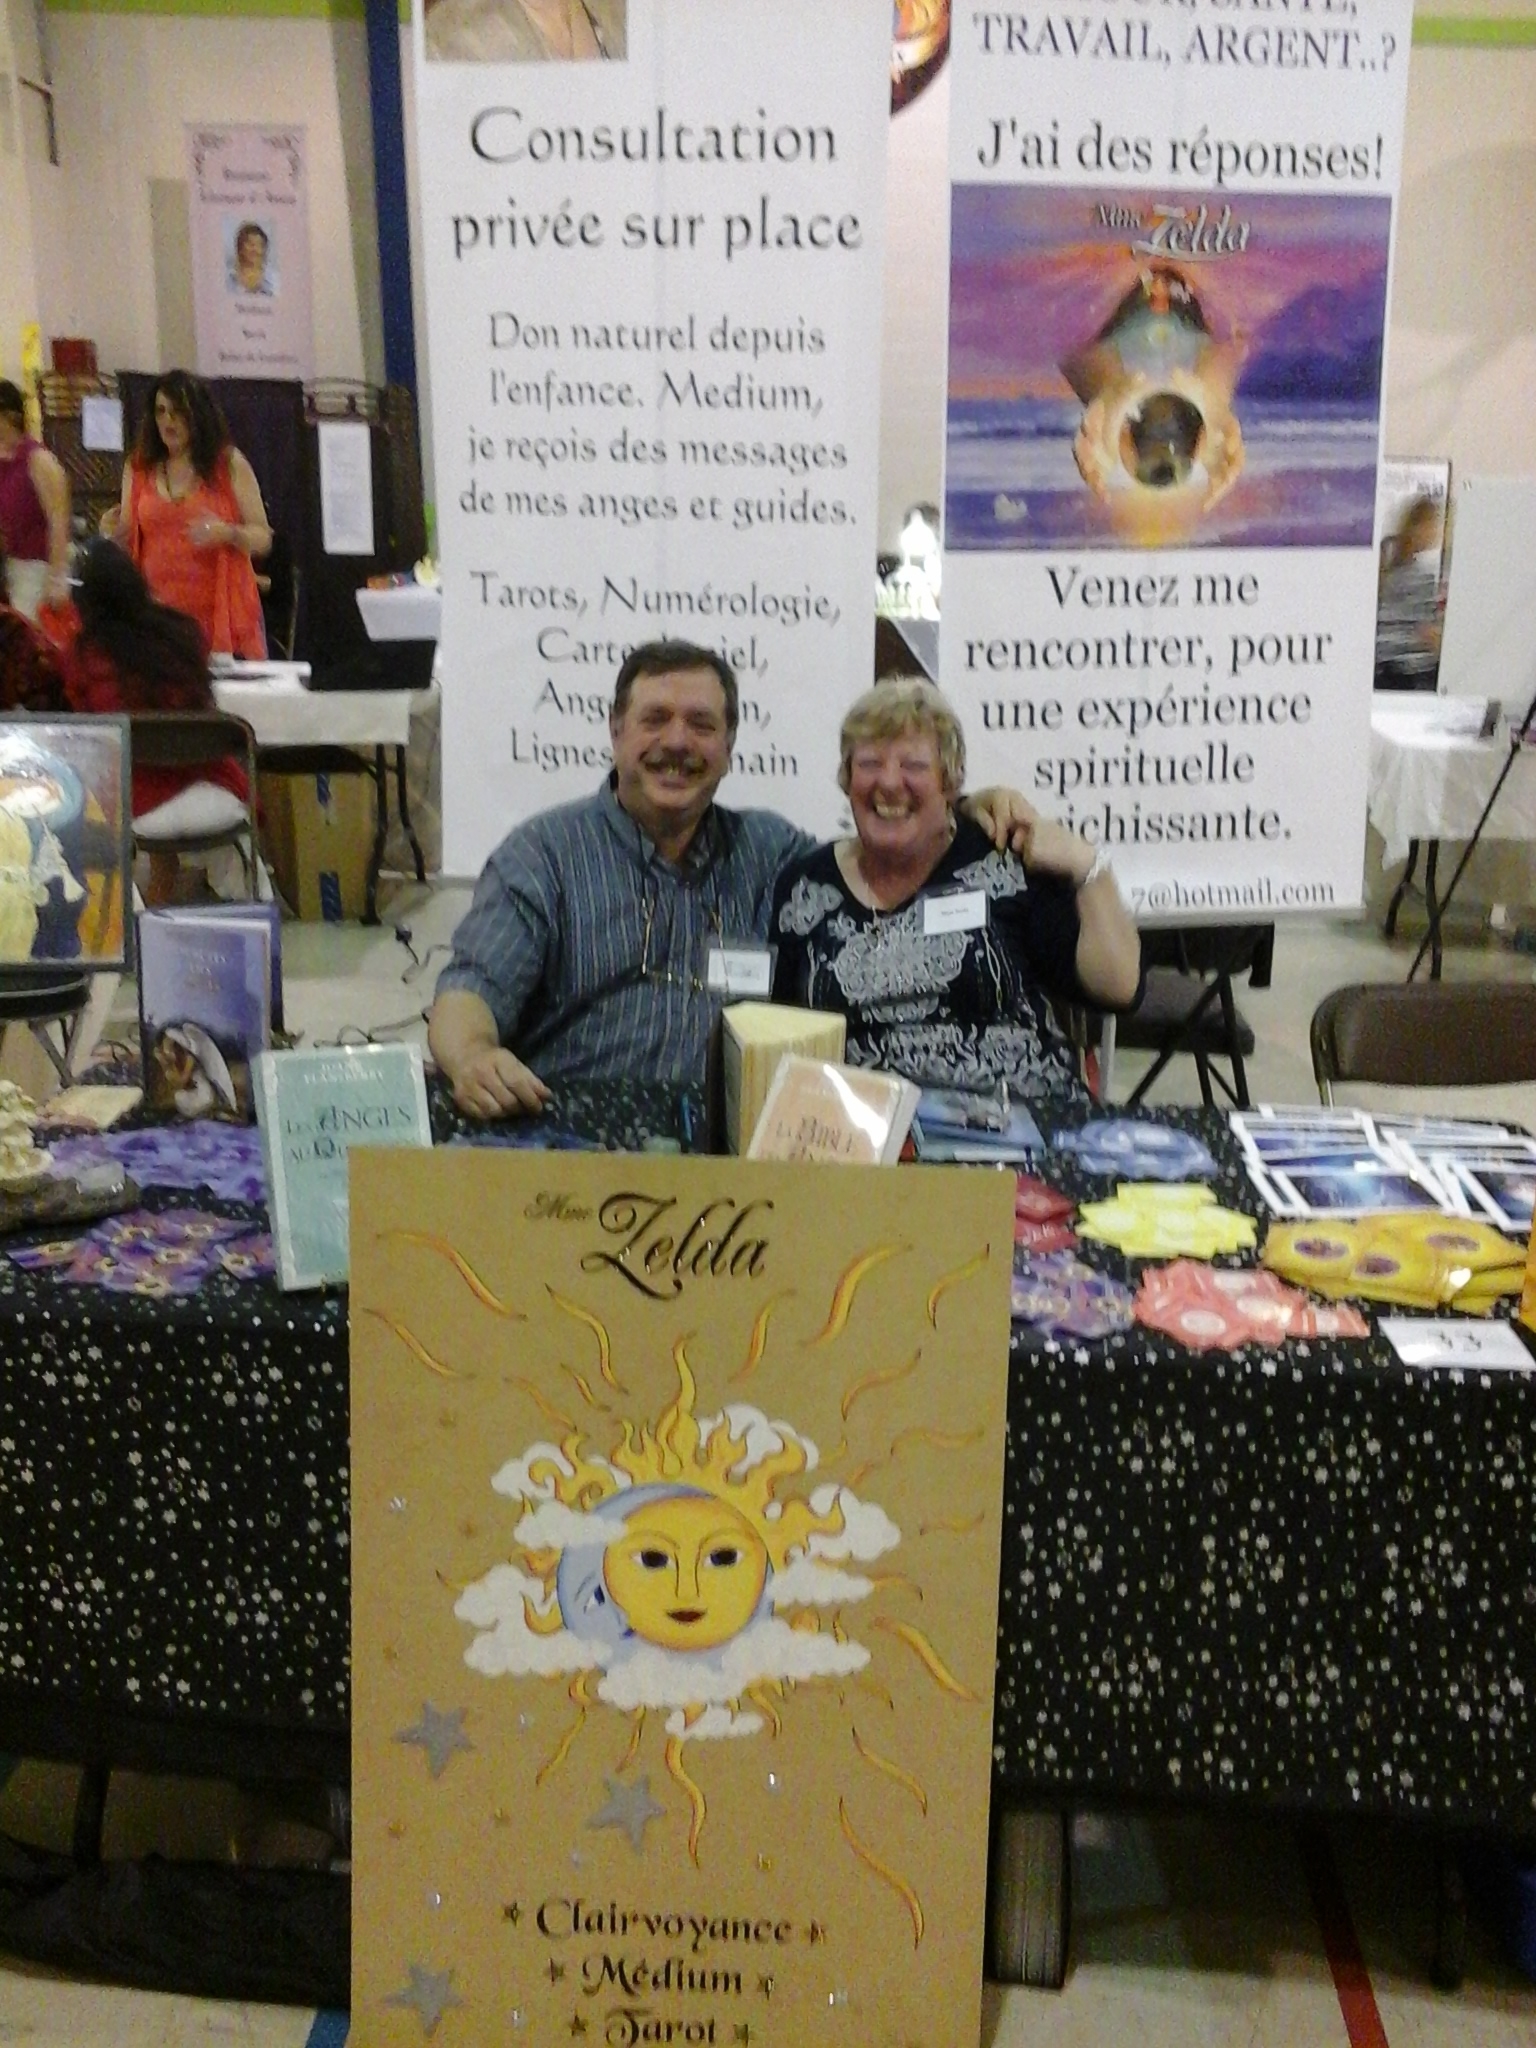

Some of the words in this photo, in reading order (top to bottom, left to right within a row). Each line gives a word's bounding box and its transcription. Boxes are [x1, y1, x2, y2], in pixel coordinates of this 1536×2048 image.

[972, 12, 1172, 68] TRAVAIL,
[469, 106, 837, 164] Consultation
[976, 117, 1061, 168] J'ai
[1077, 121, 1153, 171] des
[1169, 125, 1385, 187] réponses!
[451, 197, 604, 260] privée
[622, 210, 704, 248] sur
[723, 196, 864, 262] place
[1131, 203, 1251, 263] Zelda
[489, 311, 560, 351] Don
[571, 314, 697, 352] naturel
[709, 314, 826, 360] depuis
[489, 368, 645, 413] l'enfance.
[656, 368, 824, 417] Medium,
[468, 426, 495, 466] je
[505, 427, 597, 469] reçois
[609, 427, 668, 464] des
[679, 441, 848, 475] messages
[459, 480, 495, 515] de
[504, 494, 568, 518] mes
[578, 495, 680, 526] anges
[689, 498, 723, 522] et
[732, 490, 857, 530] guides.
[469, 570, 589, 618] Tarots,
[600, 575, 842, 627] Numérologie,
[1046, 565, 1180, 608] Venez
[1194, 574, 1260, 606] me
[964, 632, 1214, 674] rencontrer,
[1228, 631, 1333, 677] pour
[981, 701, 1063, 732] une
[1077, 684, 1313, 737] expérience
[510, 727, 614, 772] Lignes
[1033, 738, 1256, 795] spirituelle
[580, 1191, 775, 1301] Zelda
[535, 1897, 795, 1953] Clairvoyance
[581, 1953, 744, 1999] Médium
[605, 2007, 717, 2048] Tarot
